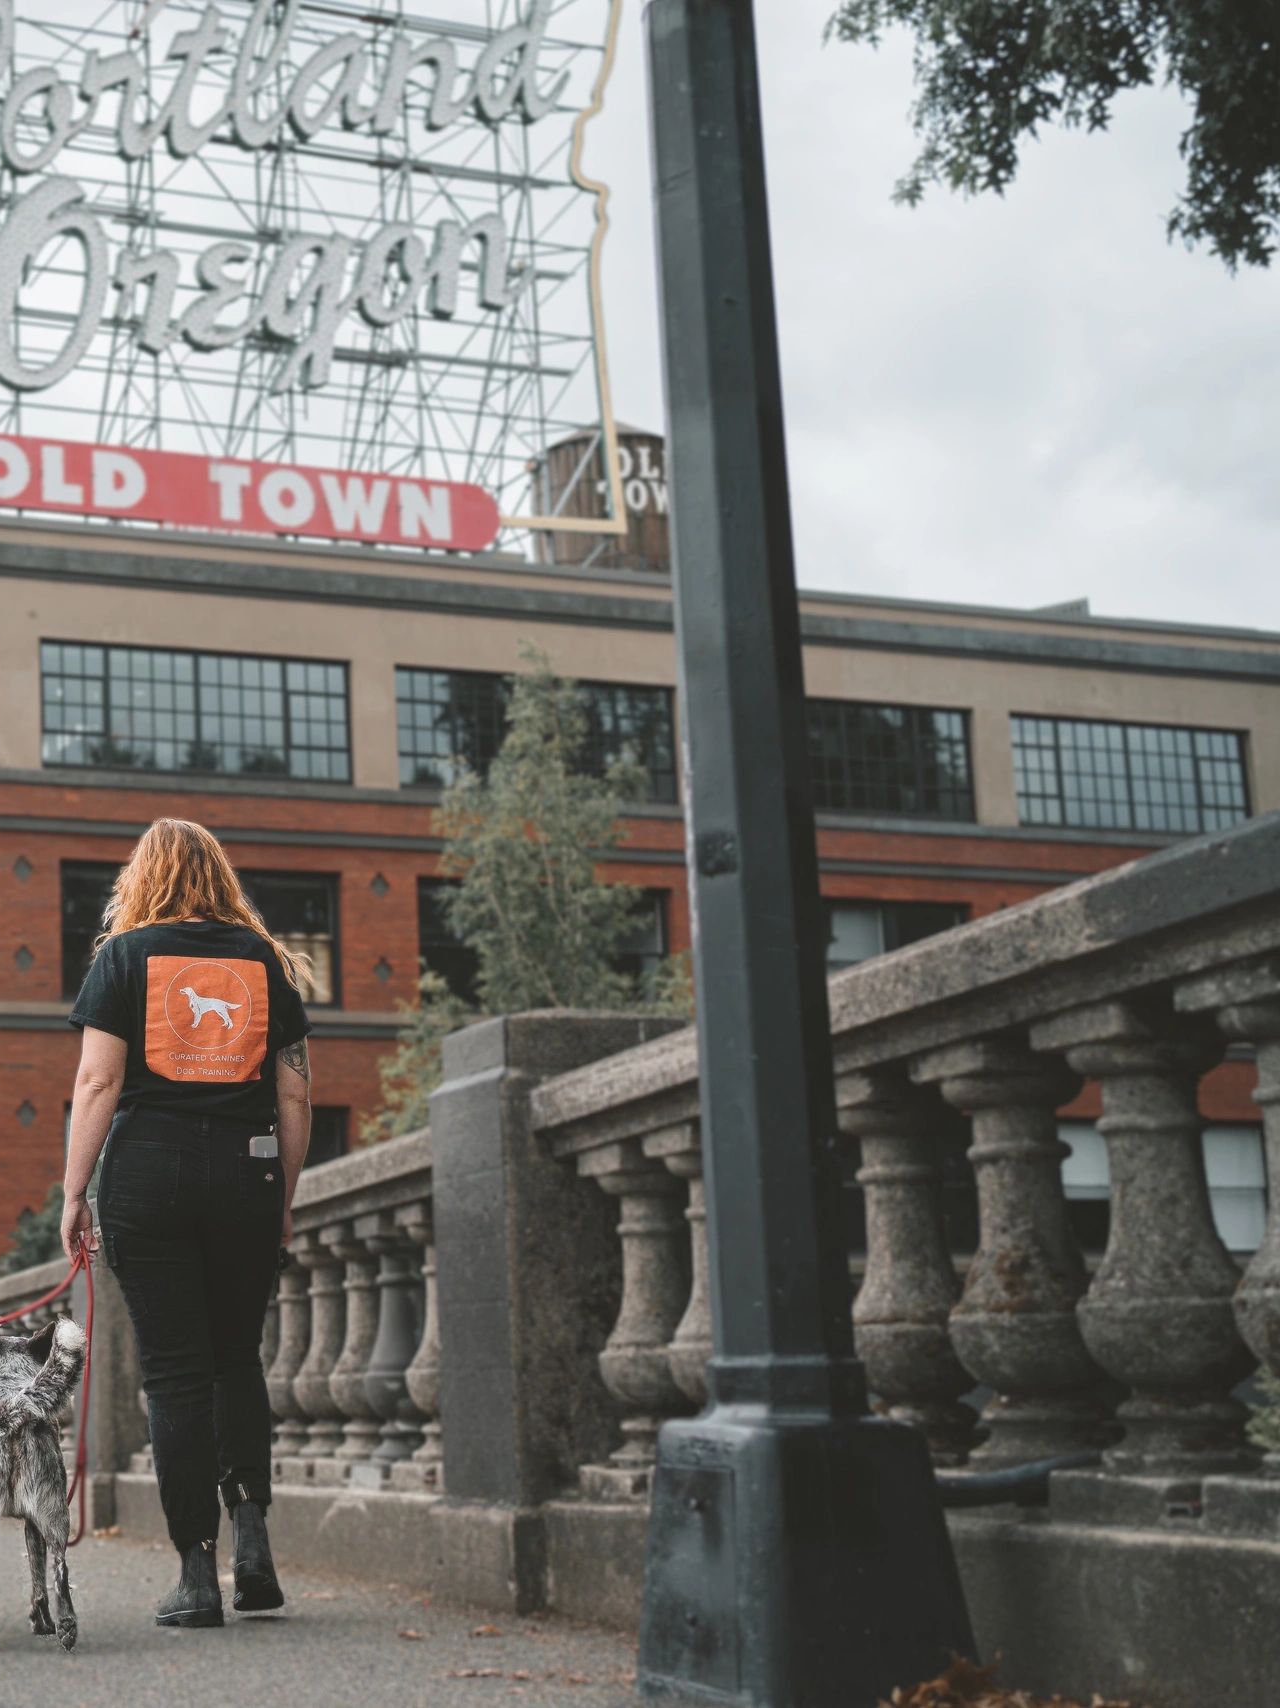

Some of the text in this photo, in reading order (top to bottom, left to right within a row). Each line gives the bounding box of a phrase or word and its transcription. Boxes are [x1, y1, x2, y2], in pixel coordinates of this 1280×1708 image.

[617, 446, 668, 478] OL
[209, 461, 453, 542] TOWN
[168, 1051, 245, 1063] CURATED CANINES
[176, 1066, 237, 1077] DOG TRAINING
